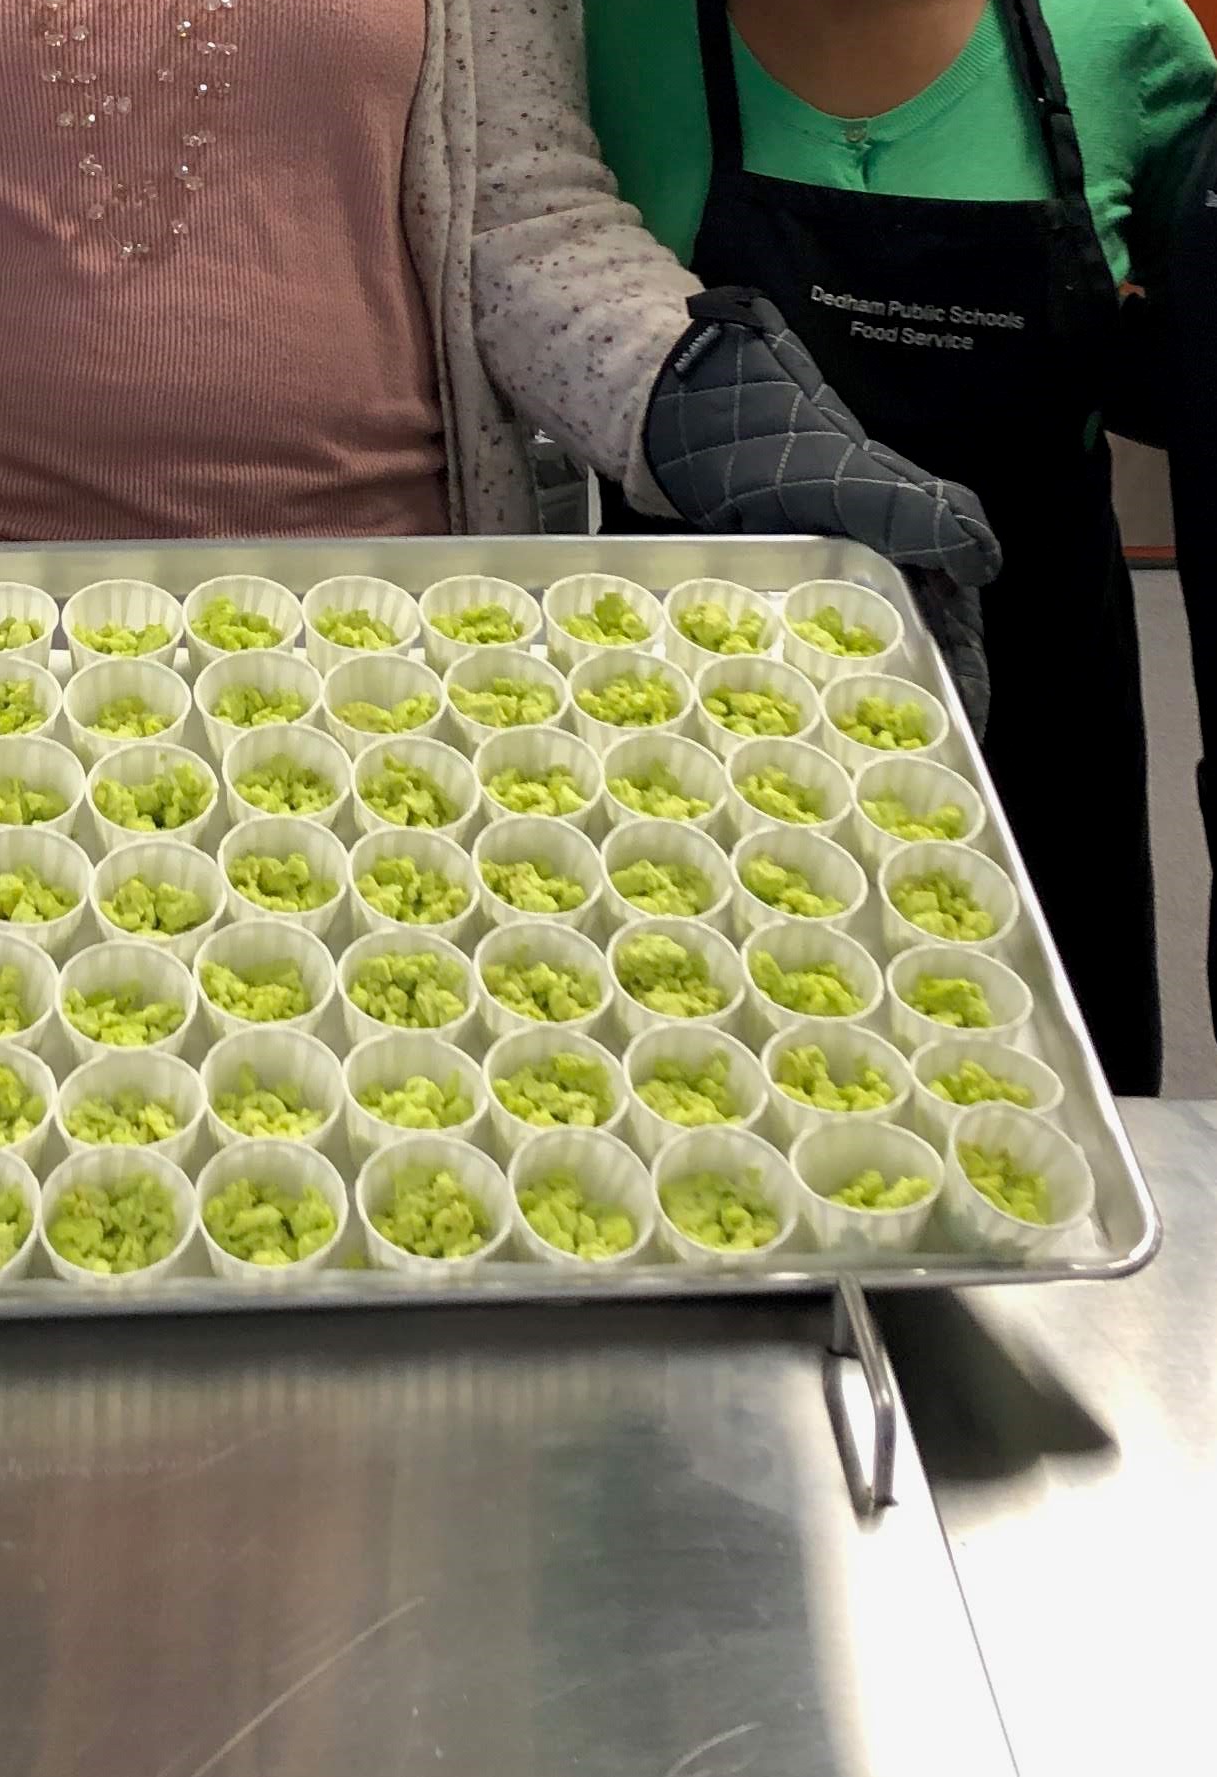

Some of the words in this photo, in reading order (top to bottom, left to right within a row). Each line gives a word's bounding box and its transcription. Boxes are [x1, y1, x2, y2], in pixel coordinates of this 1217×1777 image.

[810, 284, 887, 316] Dedham
[887, 300, 946, 322] Public
[949, 305, 1025, 330] Schools
[849, 320, 899, 343] Food
[900, 327, 974, 350] Service
